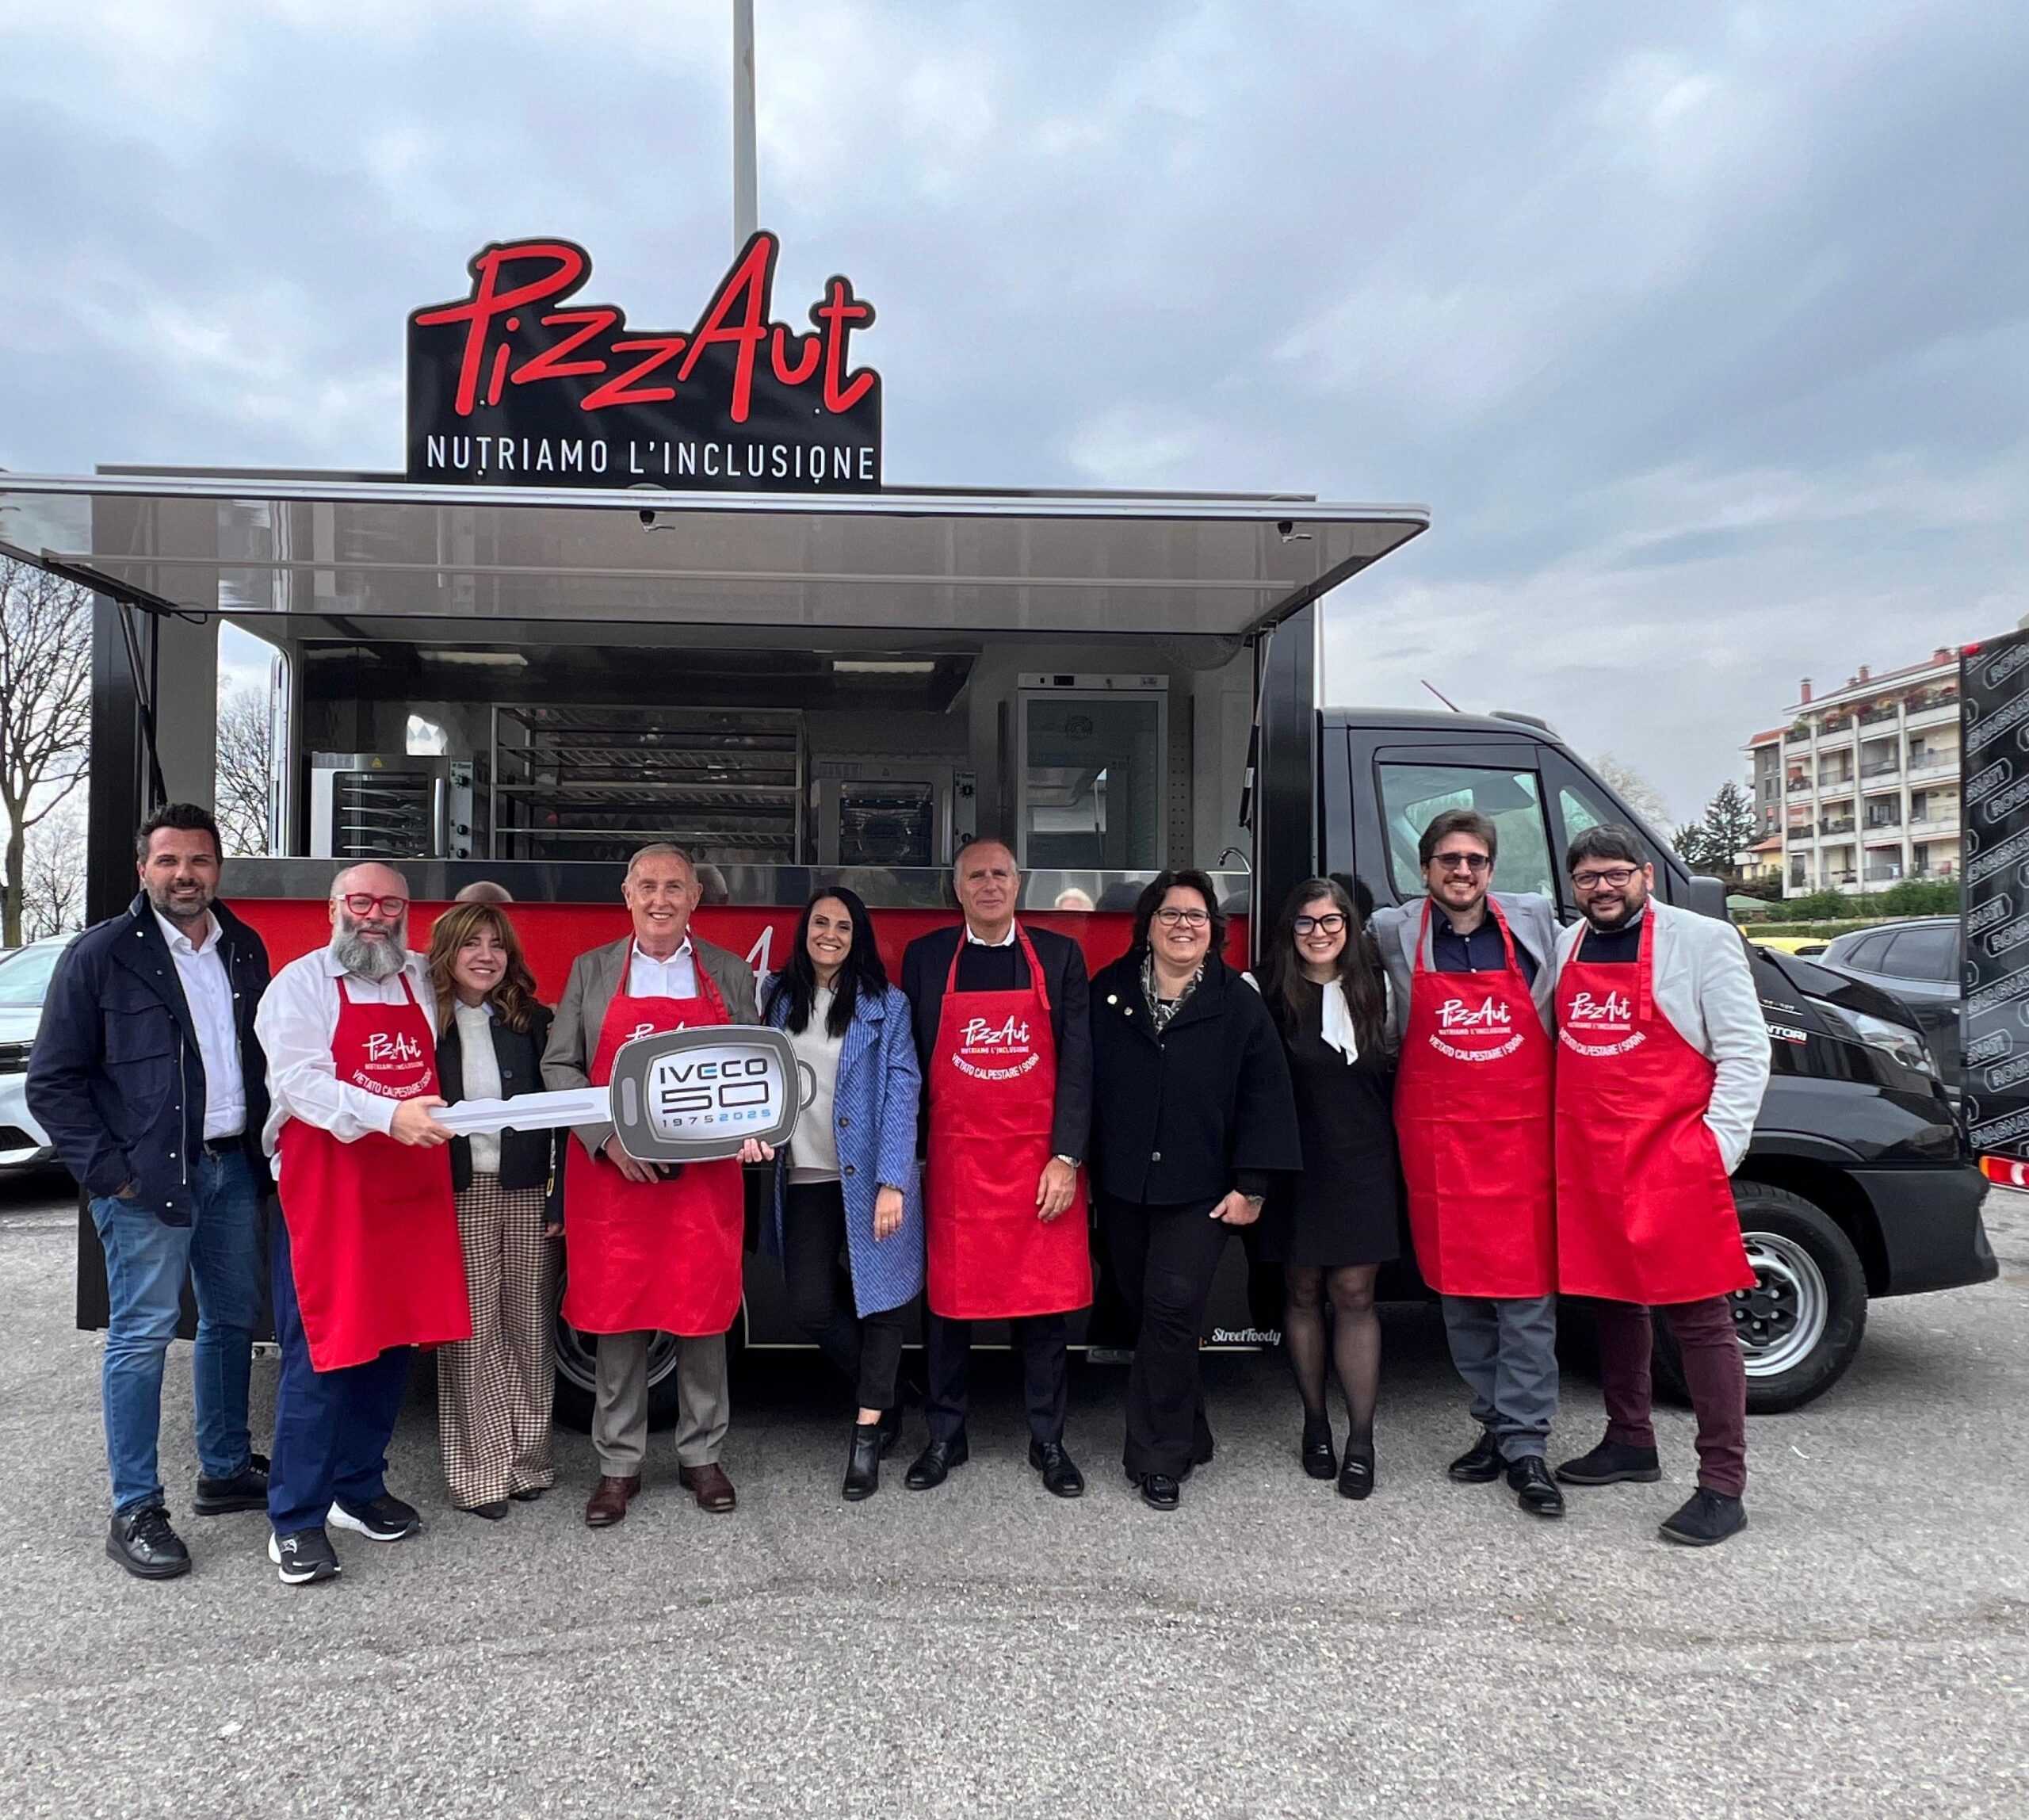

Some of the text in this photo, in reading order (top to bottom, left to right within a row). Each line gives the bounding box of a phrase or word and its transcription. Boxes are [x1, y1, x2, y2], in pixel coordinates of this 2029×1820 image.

[416, 237, 873, 422] PizzAut
[426, 435, 874, 480] NUTRIAMO L'INCLUSIONE
[1435, 996, 1511, 1027] PizzAut
[1569, 990, 1632, 1022] PizzAut
[361, 1031, 422, 1061] PizzAut
[960, 1015, 1030, 1046] PizzAut
[659, 1057, 768, 1084] IVECO
[661, 1080, 769, 1114] 50
[663, 1109, 771, 1127] 1975 2025
